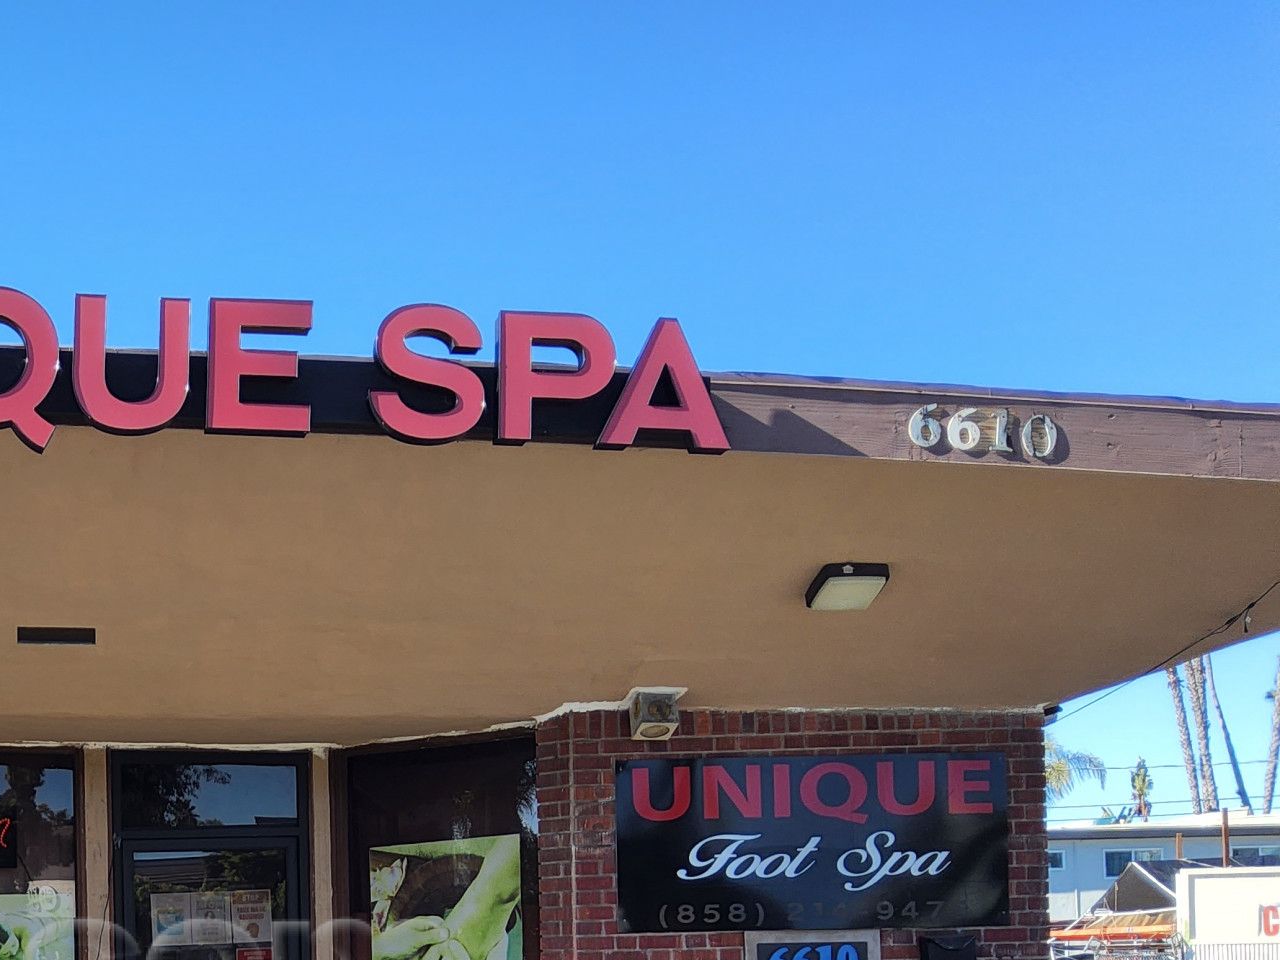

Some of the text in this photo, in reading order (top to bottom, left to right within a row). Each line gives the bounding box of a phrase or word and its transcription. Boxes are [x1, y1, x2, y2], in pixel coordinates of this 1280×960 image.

[368, 303, 731, 454] SPA
[907, 403, 1059, 458] 6610
[631, 759, 994, 824] UNIQUE
[677, 831, 951, 891] Foot Spa
[658, 902, 766, 929] (858)
